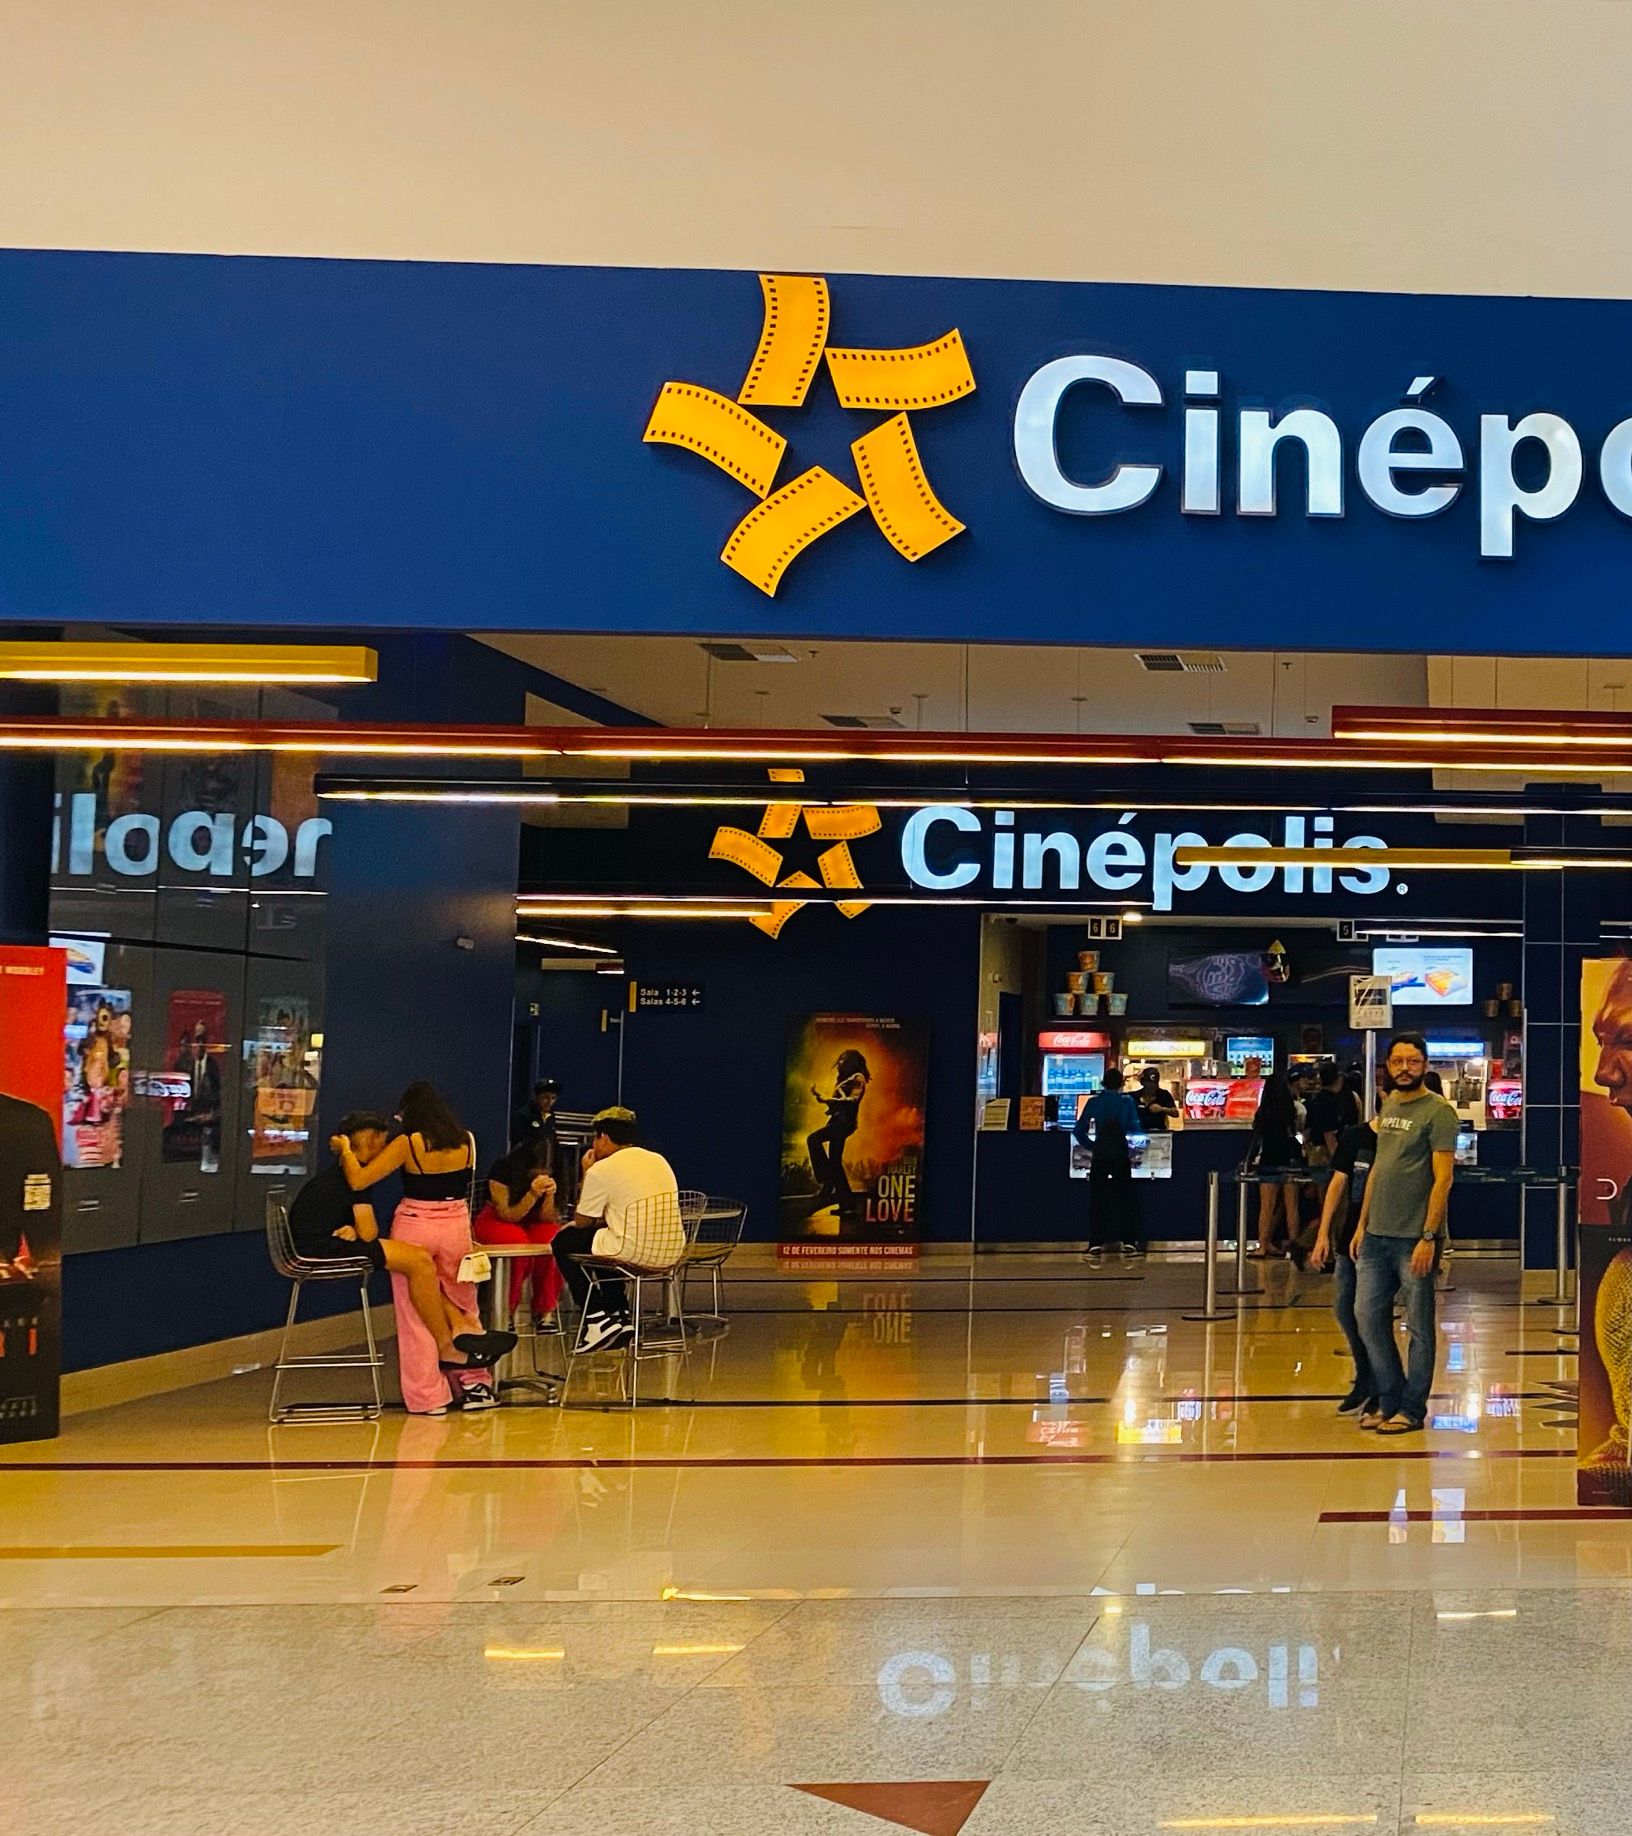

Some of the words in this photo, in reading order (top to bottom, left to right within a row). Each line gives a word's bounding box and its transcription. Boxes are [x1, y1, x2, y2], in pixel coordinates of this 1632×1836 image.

[901, 805, 1391, 910] Cinépolis
[1093, 922, 1099, 933] 6
[1110, 923, 1115, 933] 6
[1380, 1117, 1413, 1131] PIPELINE
[878, 1175, 916, 1198] ONE
[866, 1199, 915, 1222] LOVE
[791, 1246, 801, 1255] DE
[802, 1246, 836, 1255] FEVEREIRO
[837, 1246, 868, 1255] SOMENTE
[869, 1246, 883, 1255] NOS
[884, 1246, 913, 1255] CINEMAS
